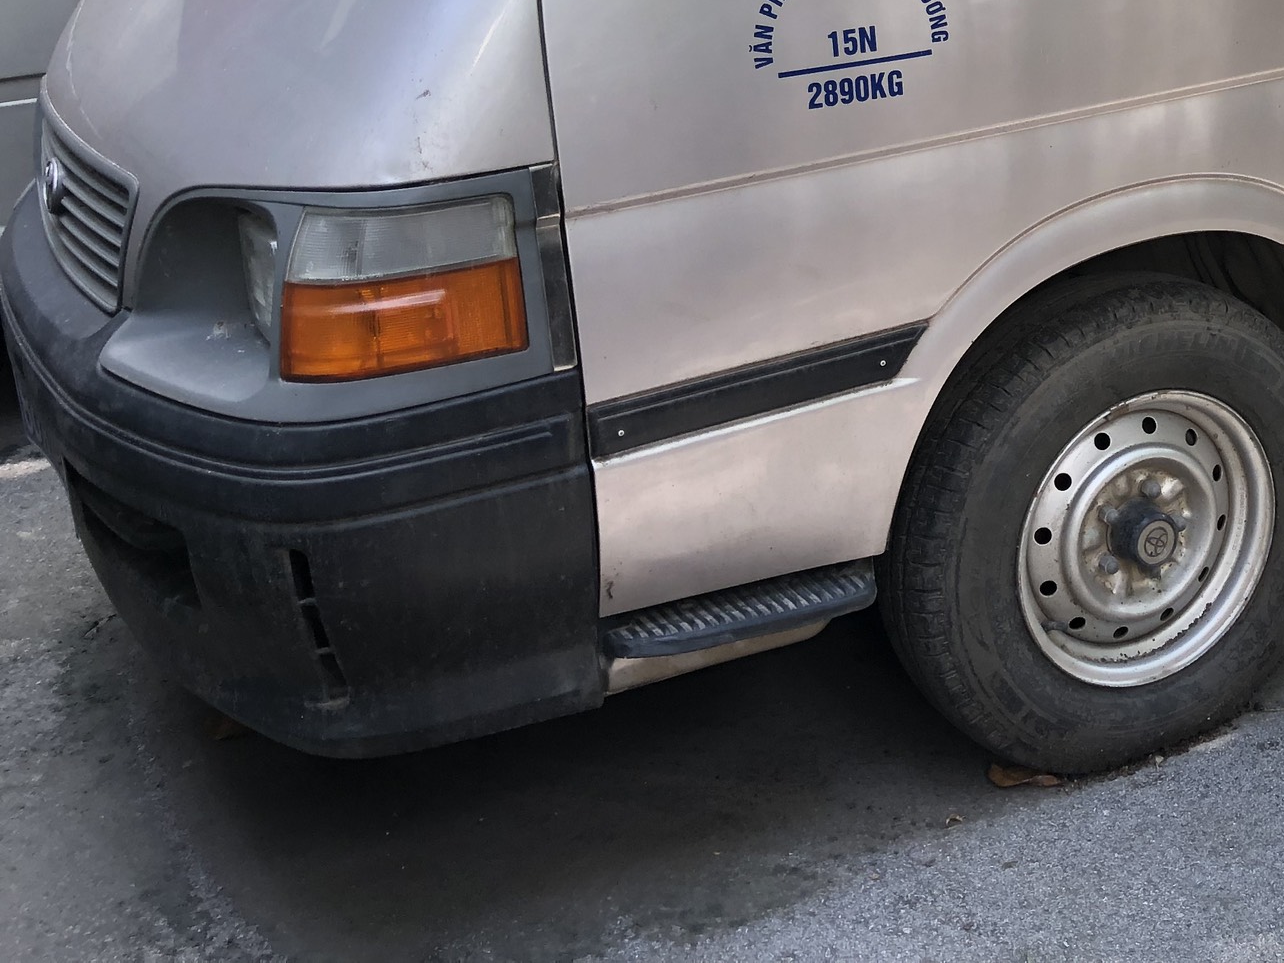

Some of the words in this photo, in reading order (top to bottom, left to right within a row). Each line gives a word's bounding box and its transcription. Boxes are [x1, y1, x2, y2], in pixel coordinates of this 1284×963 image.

[749, 24, 775, 69] VĂN
[827, 25, 878, 57] 15N
[807, 69, 904, 110] 2890KG
